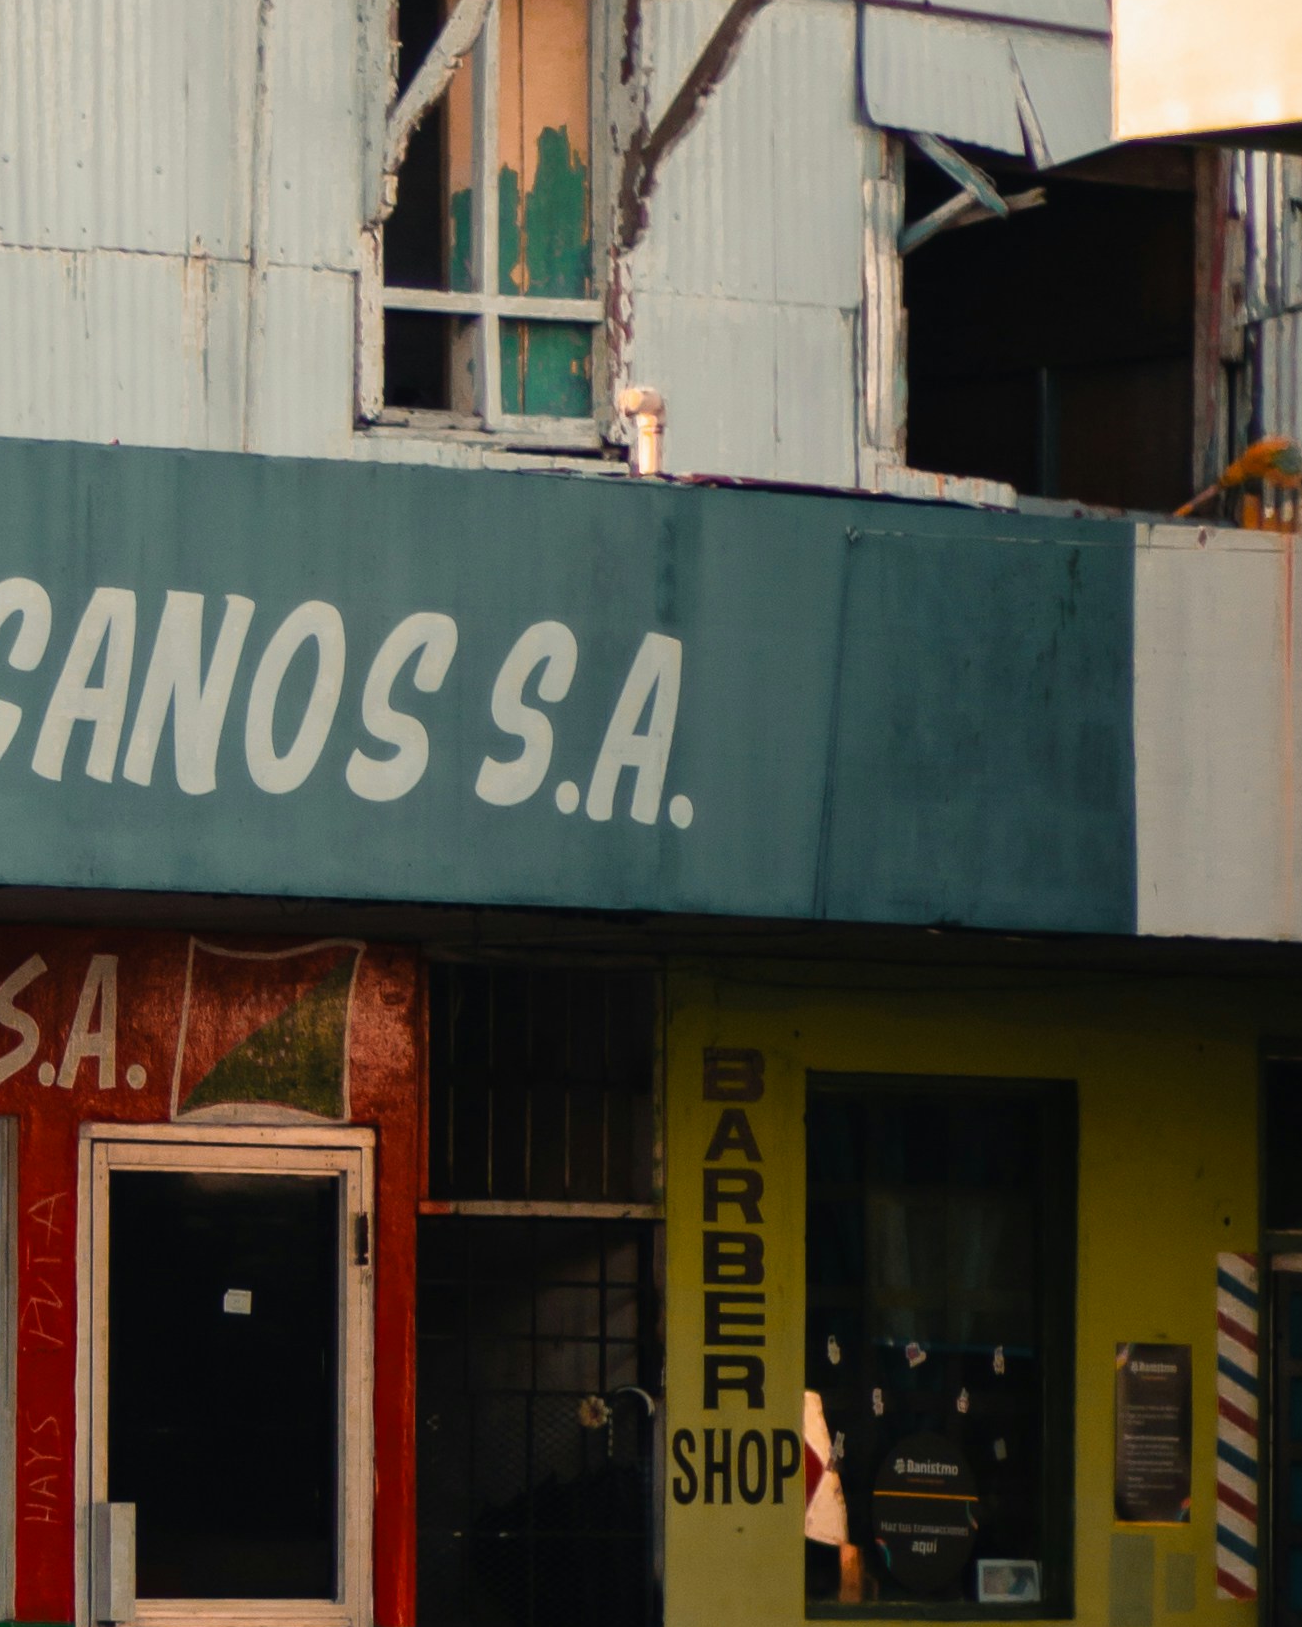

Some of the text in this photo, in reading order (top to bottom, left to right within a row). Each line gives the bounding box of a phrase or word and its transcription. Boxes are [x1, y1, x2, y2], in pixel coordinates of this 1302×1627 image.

[473, 619, 695, 830] S.A.
[701, 1046, 766, 1411] BARBER
[671, 1427, 802, 1505] SHOP
[907, 1459, 959, 1476] Banistmo
